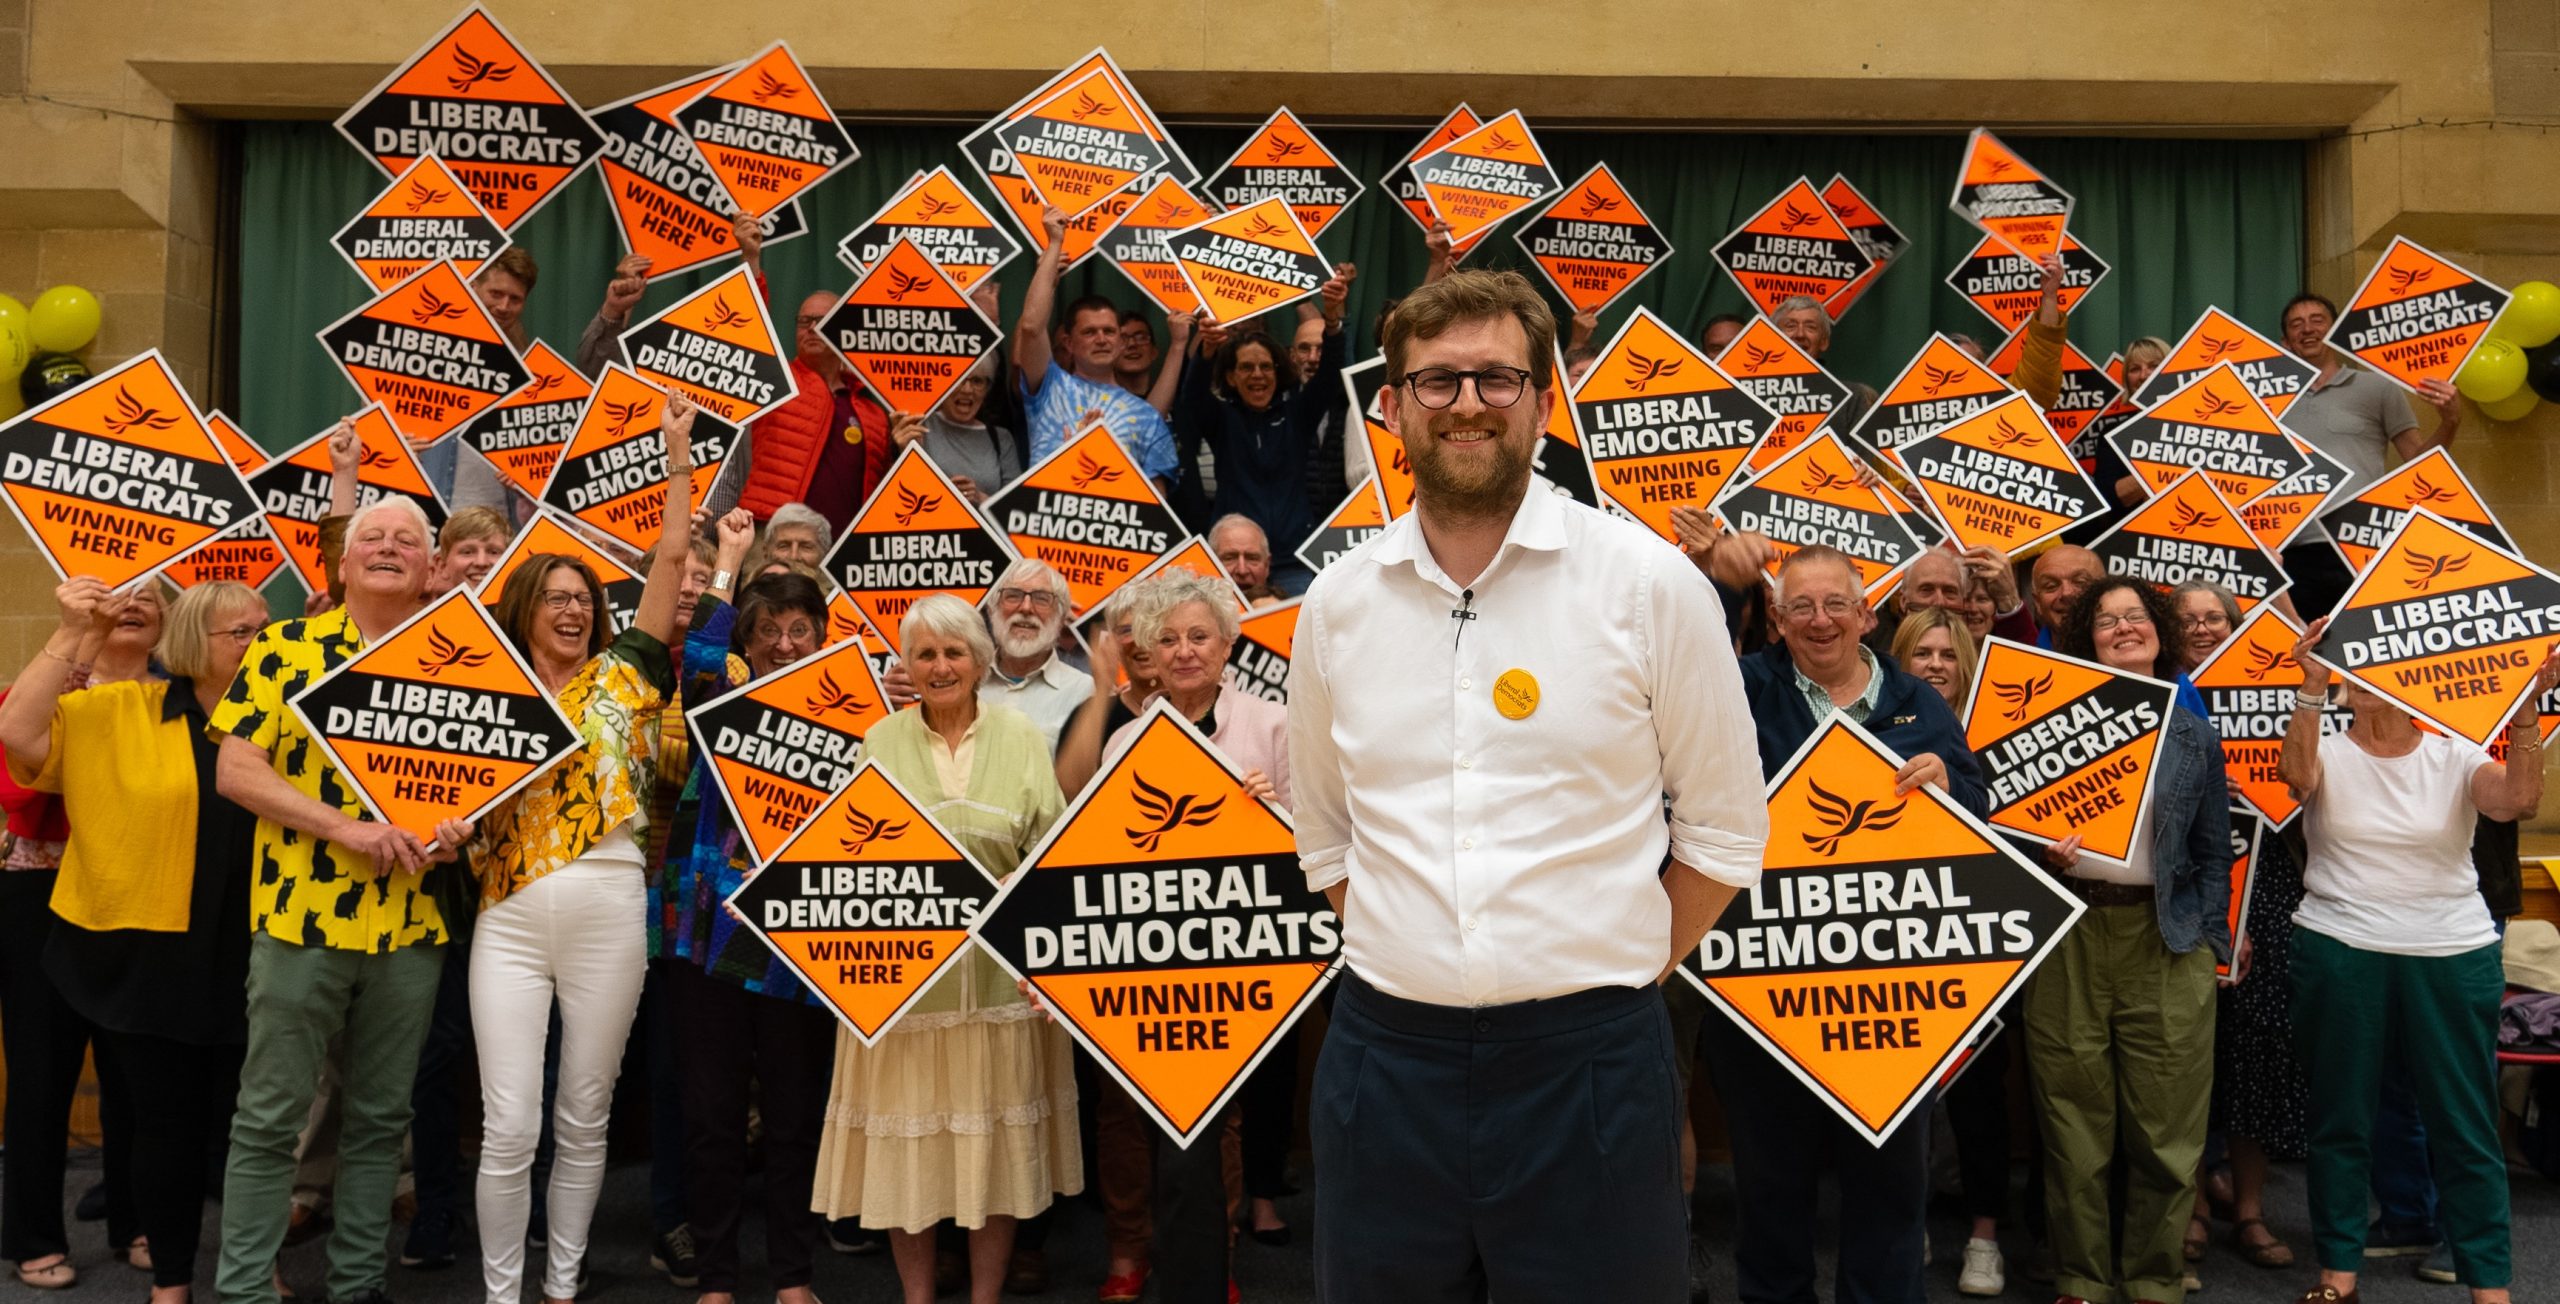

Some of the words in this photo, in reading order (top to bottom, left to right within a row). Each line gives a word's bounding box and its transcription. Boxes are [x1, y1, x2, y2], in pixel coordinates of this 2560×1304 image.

[410, 100, 547, 133] LIBERAL
[721, 104, 816, 139] LIBERAL
[375, 127, 581, 166] DEMOCRATS
[694, 120, 838, 167] DEMOCRATS
[1041, 121, 1128, 152] LIBERAL
[719, 153, 802, 180] WINNING
[1016, 136, 1147, 172] DEMOCRATS
[1450, 155, 1528, 180] LIBERAL
[737, 173, 780, 193] HERE
[1037, 164, 1114, 186] WINNING
[1052, 179, 1092, 197] HERE
[1245, 170, 1326, 185] LIBERAL
[1424, 168, 1543, 199] DEMOCRATS
[1224, 187, 1347, 205] DEMOCRATS
[1441, 191, 1509, 211] WINNING
[1451, 204, 1487, 219] HERE
[625, 181, 728, 245] WINNING
[380, 219, 468, 239] LIBERAL
[641, 213, 695, 252] HERE
[1556, 221, 1636, 243] LIBERAL
[354, 240, 490, 259] DEMOCRATS
[1209, 235, 1299, 270] LIBERAL
[1534, 239, 1655, 263] DEMOCRATS
[1755, 237, 1837, 259] LIBERAL
[1180, 244, 1318, 290] DEMOCRATS
[1556, 262, 1627, 280] WINNING
[1732, 253, 1856, 279] DEMOCRATS
[1968, 269, 2092, 294] DEMOCATS
[1201, 270, 1280, 299] WINNING
[1215, 286, 1255, 305] HERE
[1573, 278, 1609, 291] HERE
[1754, 278, 1827, 295] WINNING
[863, 308, 957, 331] LIBERAL
[2369, 290, 2464, 326] LIBERAL
[2349, 301, 2494, 350] DEMOCRATS
[377, 323, 485, 365] LIBERAL
[667, 330, 755, 375] LIBERAL
[841, 330, 981, 355] DEMOCRATS
[2382, 333, 2468, 362] WINNING
[345, 341, 510, 394] DEMOCRATS
[637, 345, 774, 405] DEMOCRATS
[870, 360, 952, 377] WINNING
[2406, 352, 2449, 372] HERE
[374, 377, 470, 409] WINNING
[891, 377, 933, 392] HERE
[396, 399, 445, 422] HERE
[1595, 396, 1720, 430] LIBERAL
[480, 422, 572, 451] DEMOCR
[1586, 420, 1756, 458] EMOCRATS
[2161, 423, 2263, 454] LIBERAL
[50, 432, 199, 490] LIBERAL
[1610, 459, 1721, 487] WINNING
[1951, 446, 2059, 490] LIBERAL
[2131, 439, 2288, 479] DEMOCRATS
[3, 452, 232, 526] DEMOCRATS
[1641, 482, 1698, 504] HERE
[1919, 458, 2084, 518] DEMOCRATS
[43, 501, 176, 546] WINNING
[1039, 491, 1143, 527] LIBERAL
[1769, 494, 1874, 535] LIBERAL
[1946, 492, 2041, 530] WINNING
[1008, 510, 1167, 555] DEMOCRATS
[1965, 515, 2015, 538] HERE
[70, 530, 138, 560] HERE
[870, 534, 967, 561] LIBERAL
[1036, 546, 1129, 573] WINNING
[2137, 536, 2242, 571] LIBERAL
[195, 566, 248, 581] HERE
[847, 561, 993, 588] DEMOCRATS
[2372, 586, 2523, 632] LIBERAL
[2342, 605, 2560, 667] DEMOCRATS
[2395, 650, 2530, 687] WINNING
[1496, 684, 1527, 710] Democrats
[1500, 678, 1520, 694] Liberal
[2213, 689, 2338, 713] LIBERL
[2433, 676, 2503, 702] HERE
[370, 681, 515, 726] LIBERAL
[326, 706, 549, 761] DEMOCRATS
[757, 710, 863, 764] LIBERA
[1985, 696, 2115, 774] LIBERAL
[366, 753, 496, 788] WINNING
[714, 726, 853, 791] DEMOCR
[395, 780, 461, 806] HERE
[2025, 755, 2139, 822] WINNING
[2065, 788, 2125, 829] HERE
[802, 866, 943, 895] LIBERAL
[1074, 864, 1281, 917] LIBERAL
[1749, 866, 1970, 920] LIBERAL
[765, 898, 980, 928] DEMOCRATS
[807, 940, 934, 961] WINNING
[1024, 911, 1339, 969] DEMOCRATS
[1699, 911, 2034, 971] DEMOCRATS
[839, 964, 902, 984] HERE
[1089, 980, 1273, 1017] WINNING
[1767, 979, 1967, 1018] WINNING
[1137, 1019, 1229, 1052] HERE
[1820, 1019, 1921, 1052] HERE
